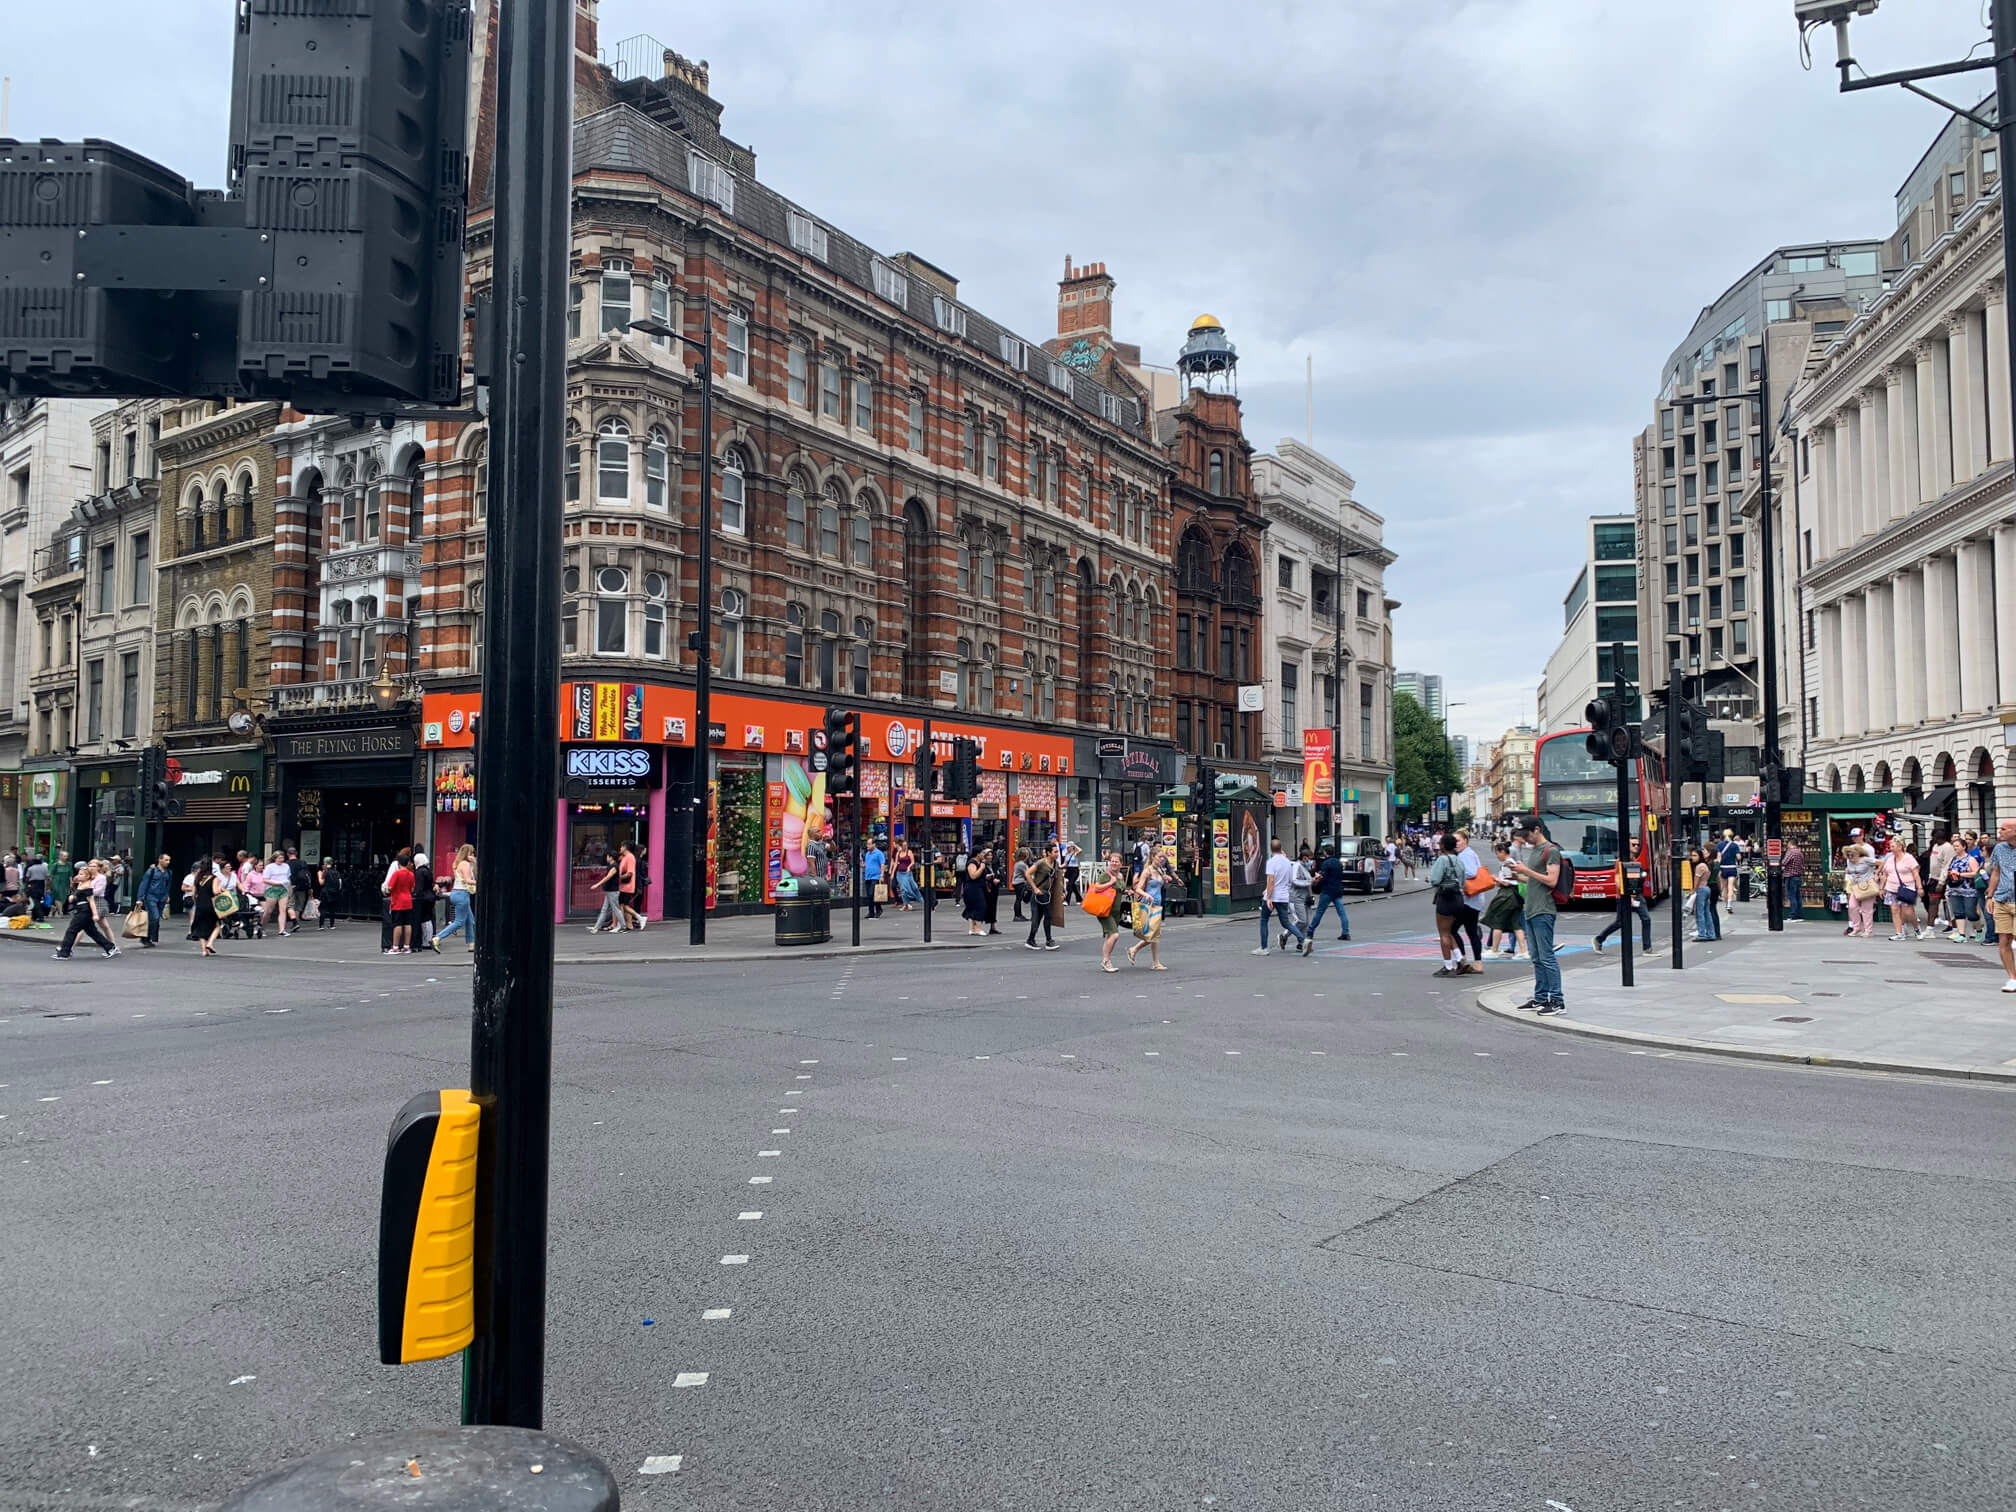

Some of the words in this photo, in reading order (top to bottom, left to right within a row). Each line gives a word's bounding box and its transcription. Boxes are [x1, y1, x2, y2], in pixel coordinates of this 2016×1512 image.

[577, 687, 592, 737] Tobacco
[624, 694, 642, 732] Vape
[290, 740, 312, 755] THE
[317, 738, 356, 753] FLYING
[361, 736, 401, 752] HORSE
[567, 749, 650, 776] KKISS
[932, 805, 954, 815] WELCOME
